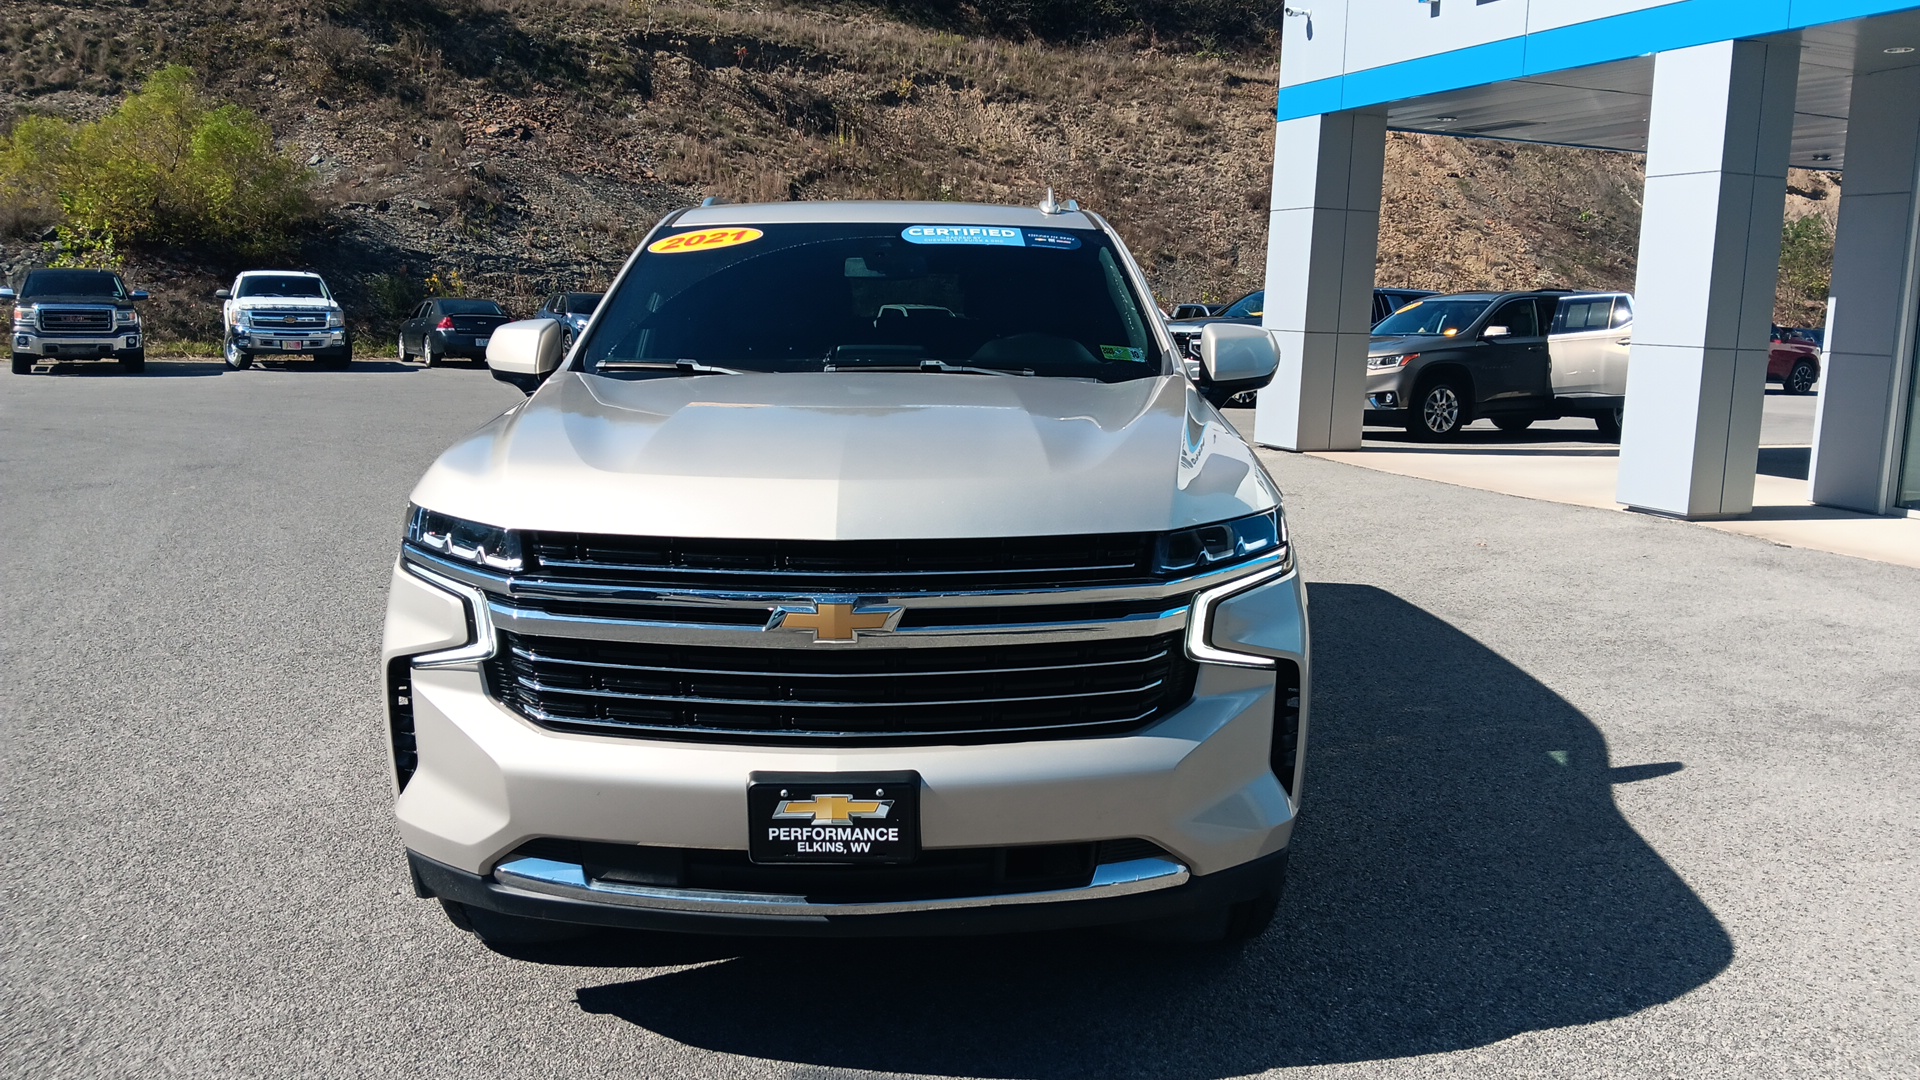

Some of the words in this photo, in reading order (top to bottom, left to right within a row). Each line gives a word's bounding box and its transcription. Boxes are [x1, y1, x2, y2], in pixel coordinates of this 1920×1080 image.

[908, 227, 1016, 238] CERTIFIED
[659, 230, 748, 251] 2021
[768, 827, 899, 842] PERFORMANCE
[797, 841, 847, 855] ELKINS,
[851, 842, 871, 853] WV
